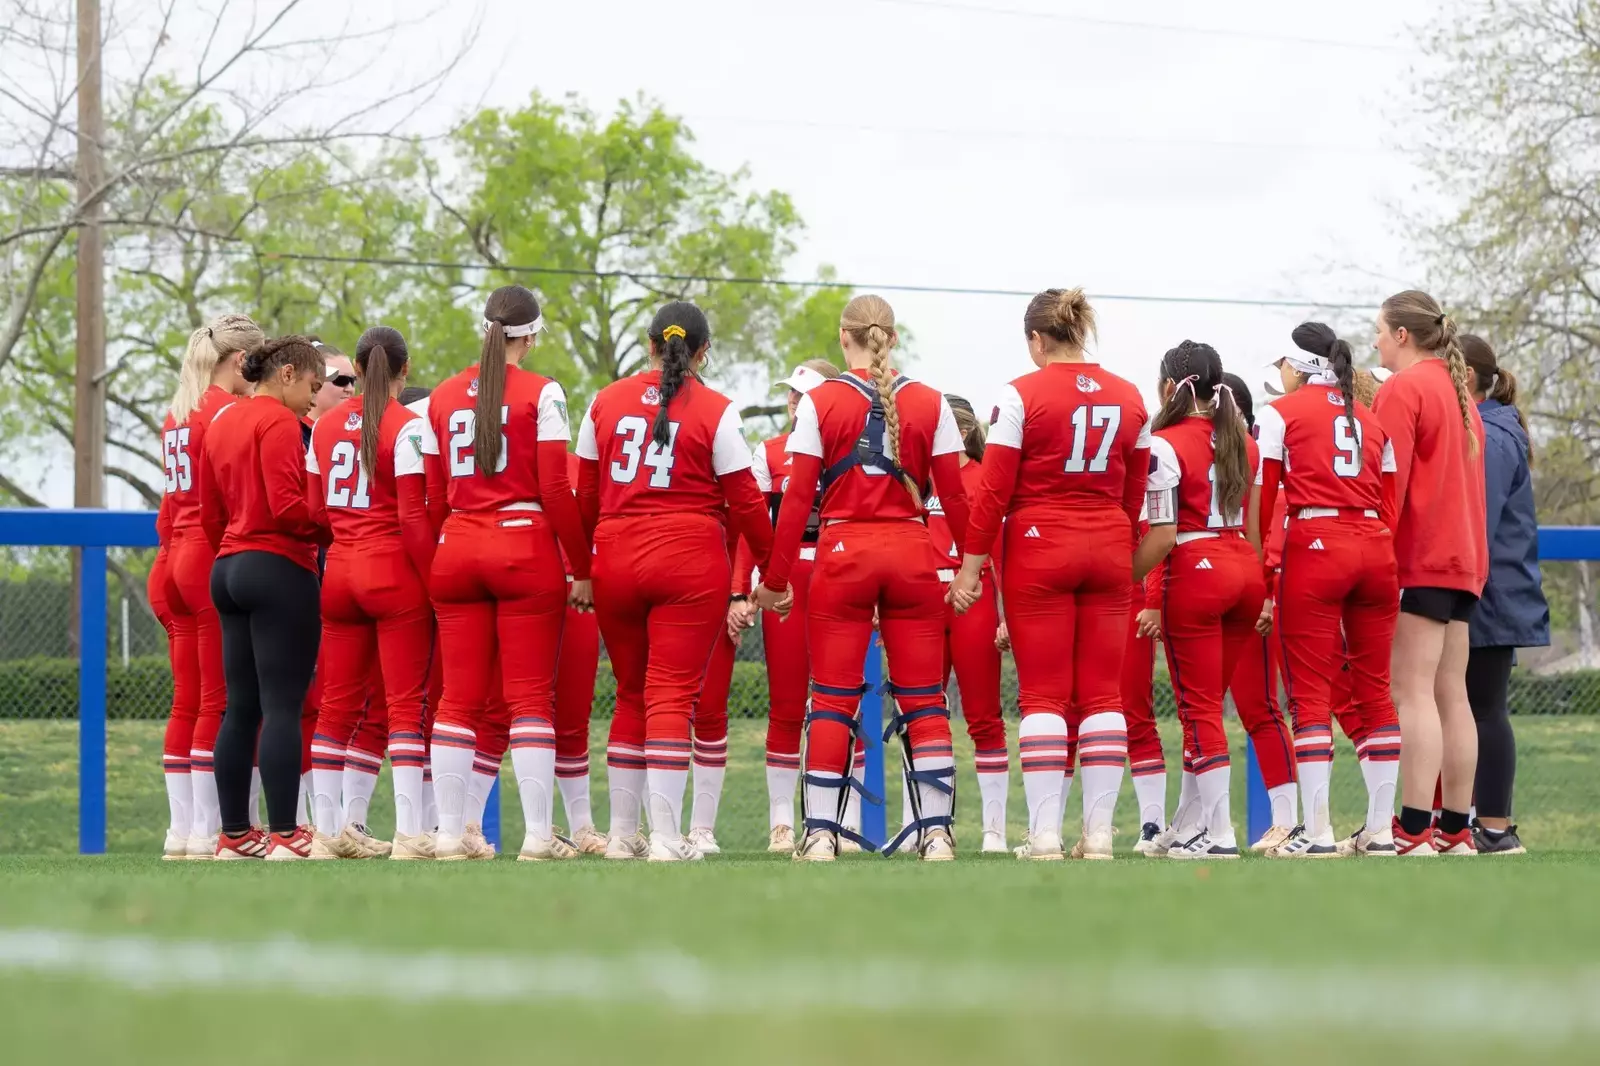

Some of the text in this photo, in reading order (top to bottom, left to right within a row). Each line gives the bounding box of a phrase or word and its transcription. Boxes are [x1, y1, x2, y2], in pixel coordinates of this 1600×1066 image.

[164, 427, 192, 494] 55
[610, 415, 680, 488] 34
[1064, 405, 1121, 473] 17
[1333, 415, 1363, 478] 9
[326, 440, 370, 508] 21
[1207, 462, 1243, 528] 1
